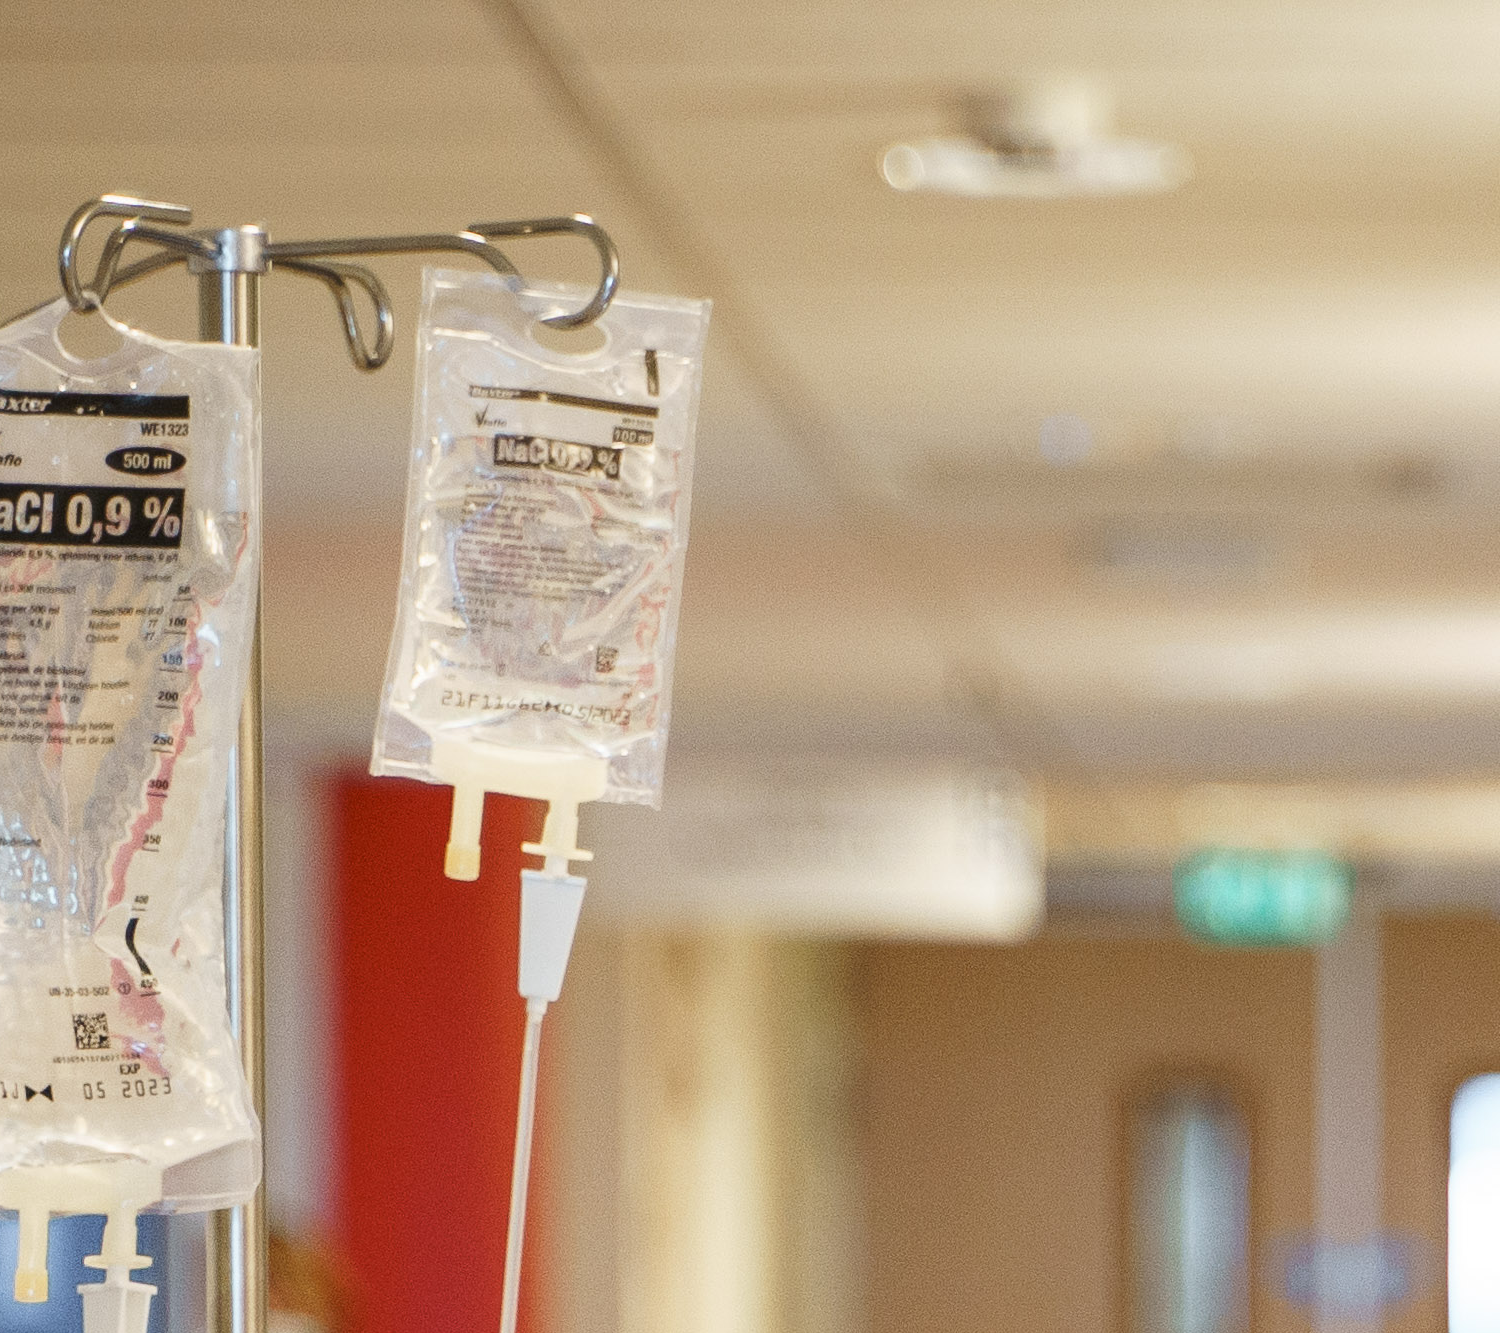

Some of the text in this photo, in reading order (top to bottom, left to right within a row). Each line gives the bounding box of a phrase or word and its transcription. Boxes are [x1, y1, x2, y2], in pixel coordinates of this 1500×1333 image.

[140, 422, 189, 437] WE1323
[615, 430, 637, 442] 100
[123, 453, 172, 470] 500 ml
[598, 450, 618, 477] %
[66, 493, 132, 543] 0,9
[143, 496, 181, 538] %
[169, 617, 188, 627] 100
[158, 691, 179, 702] 200
[150, 779, 169, 790] 300
[143, 834, 162, 846] 350
[120, 1063, 141, 1076] EXP
[83, 1081, 106, 1101] 05
[121, 1076, 172, 1099] 2023
